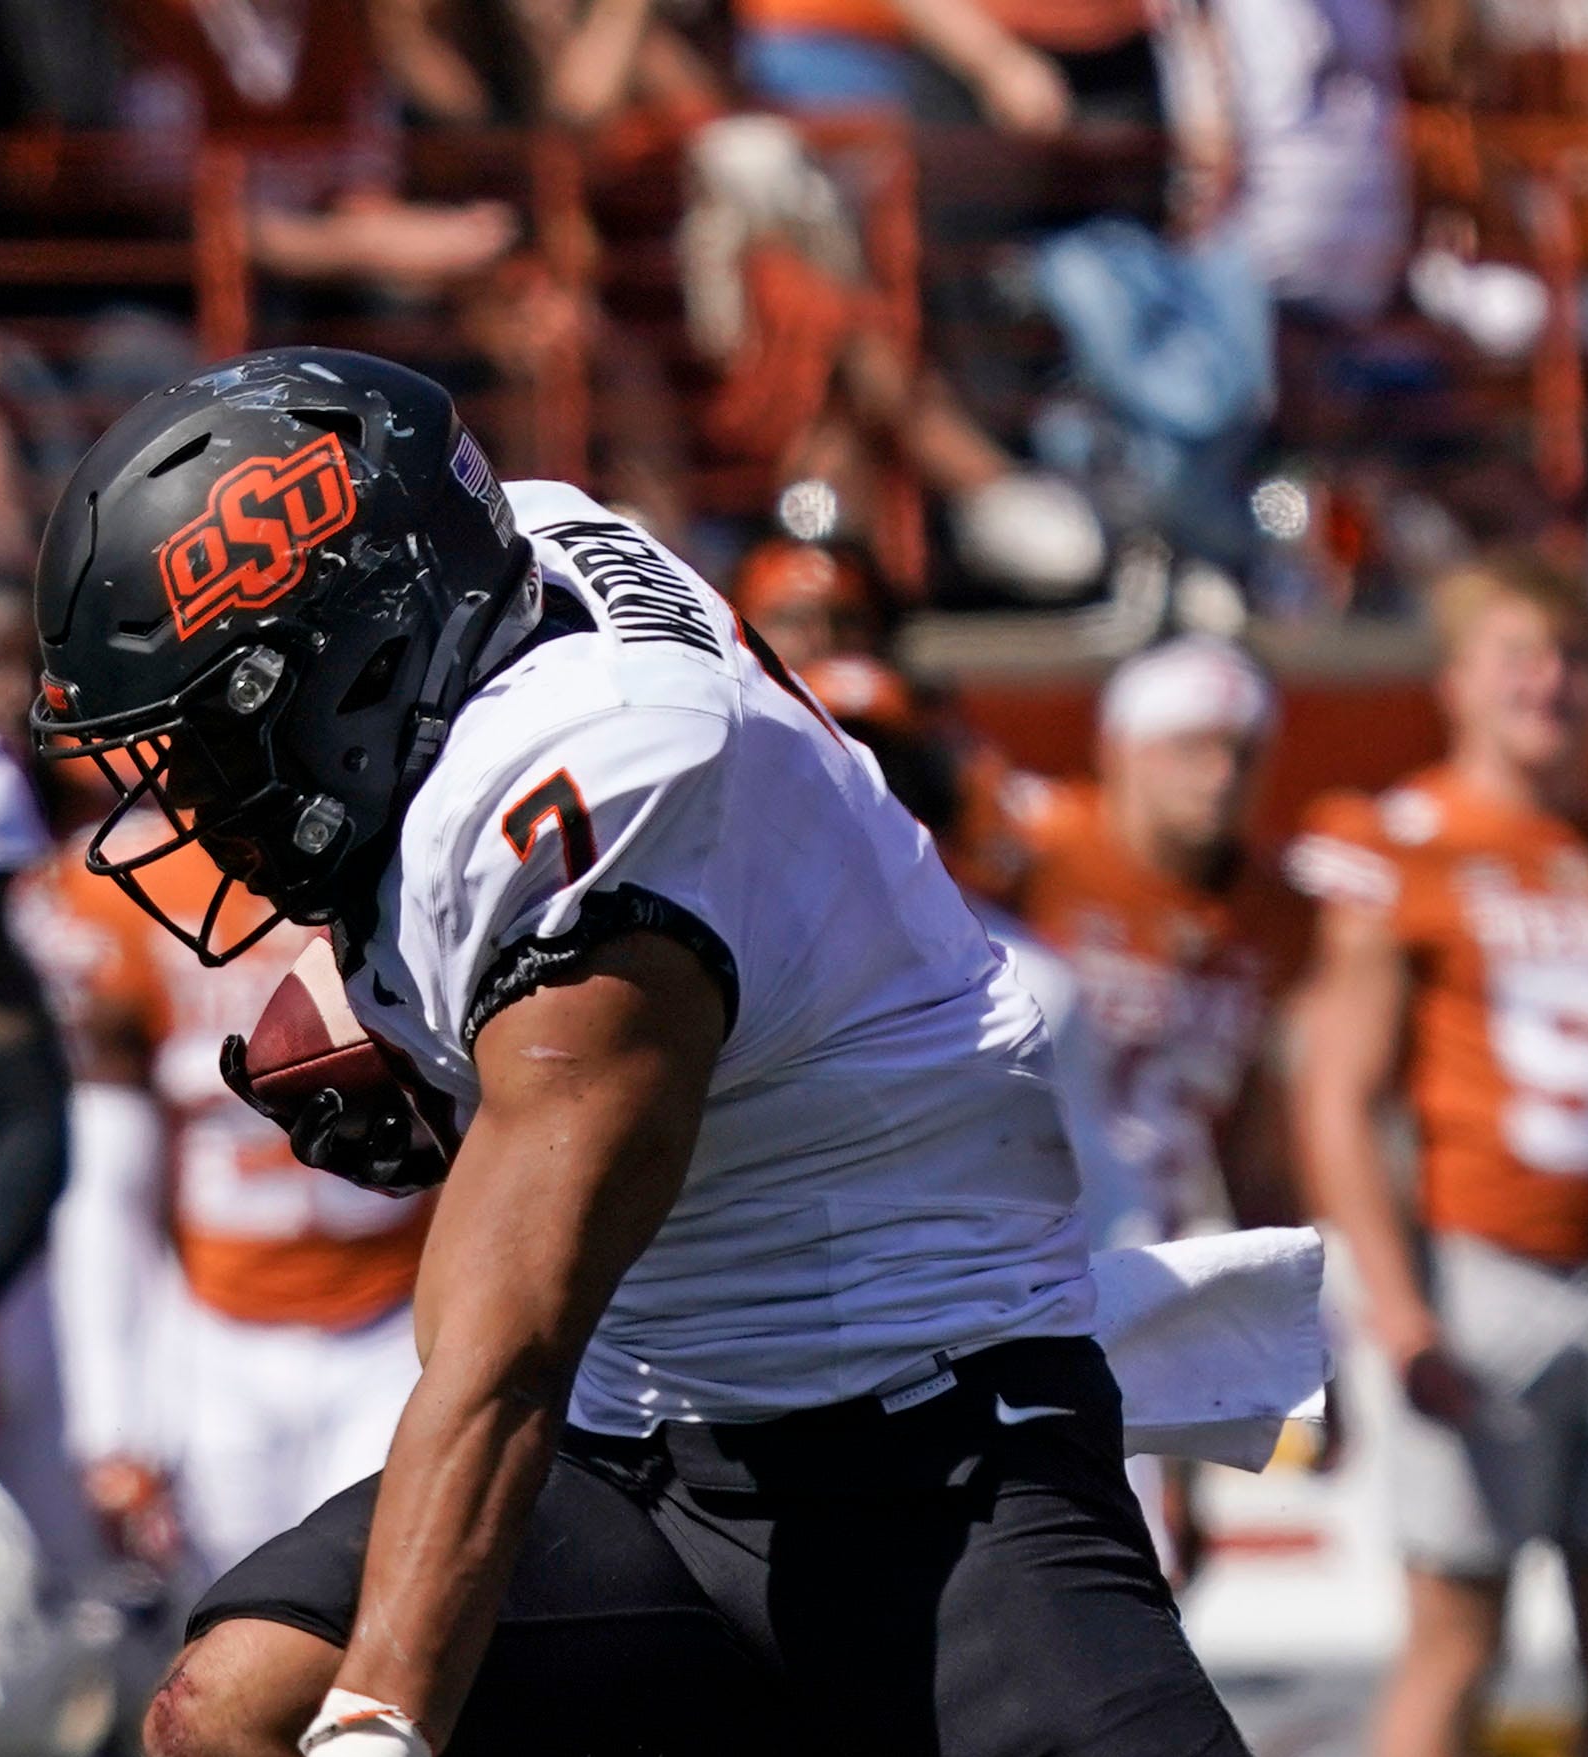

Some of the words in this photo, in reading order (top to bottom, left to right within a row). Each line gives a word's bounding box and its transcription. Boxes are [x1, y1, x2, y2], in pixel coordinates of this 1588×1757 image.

[158, 432, 357, 642] OSU
[528, 520, 725, 660] WARREN
[501, 766, 597, 890] 7
